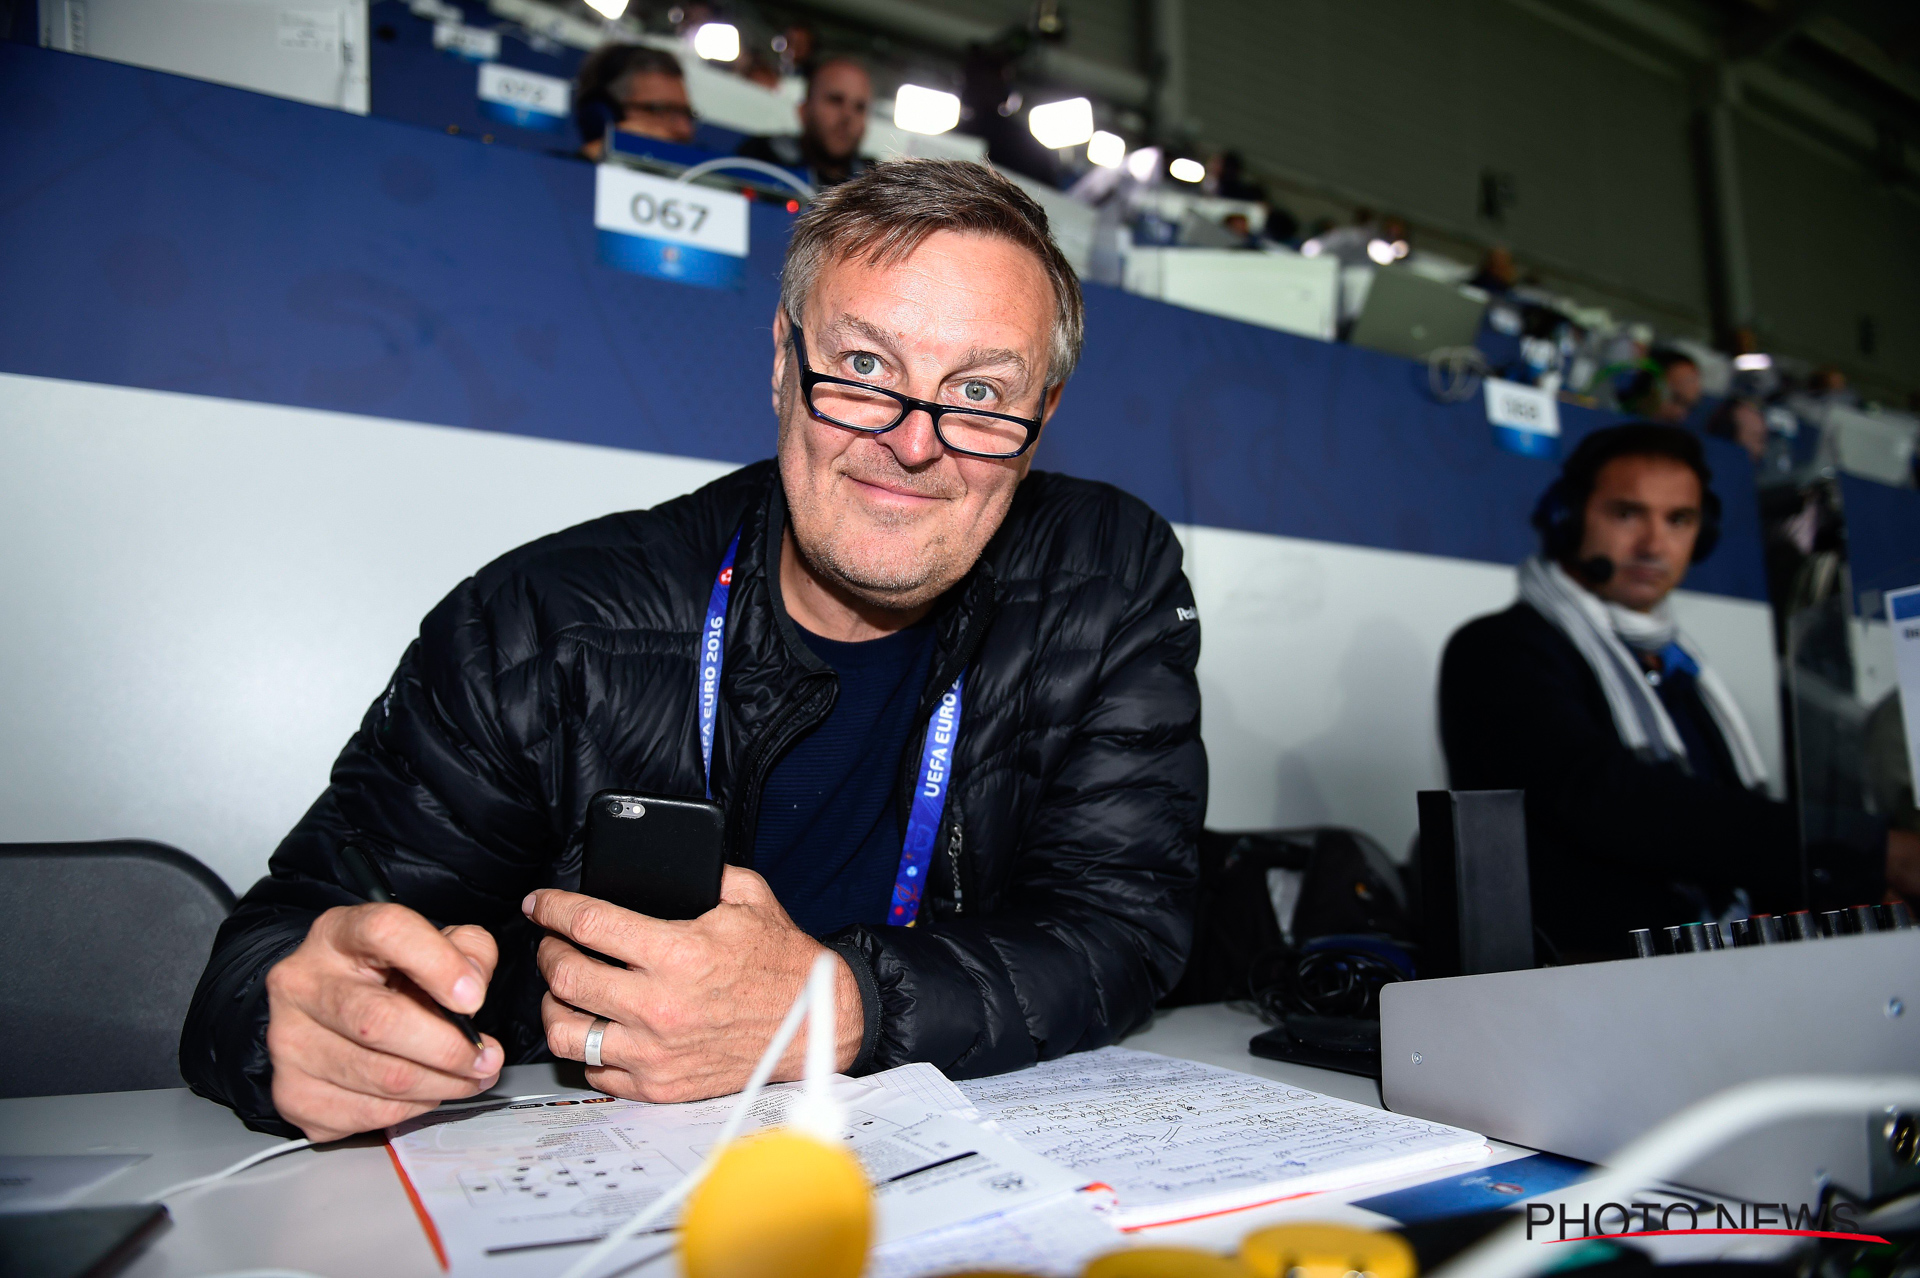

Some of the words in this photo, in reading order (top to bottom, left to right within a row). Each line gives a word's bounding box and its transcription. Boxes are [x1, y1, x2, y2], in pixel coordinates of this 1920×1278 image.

[630, 192, 709, 234] 067
[706, 616, 724, 663] 2016
[703, 666, 717, 719] EURO
[934, 692, 957, 744] EURO
[923, 747, 948, 797] UEFA
